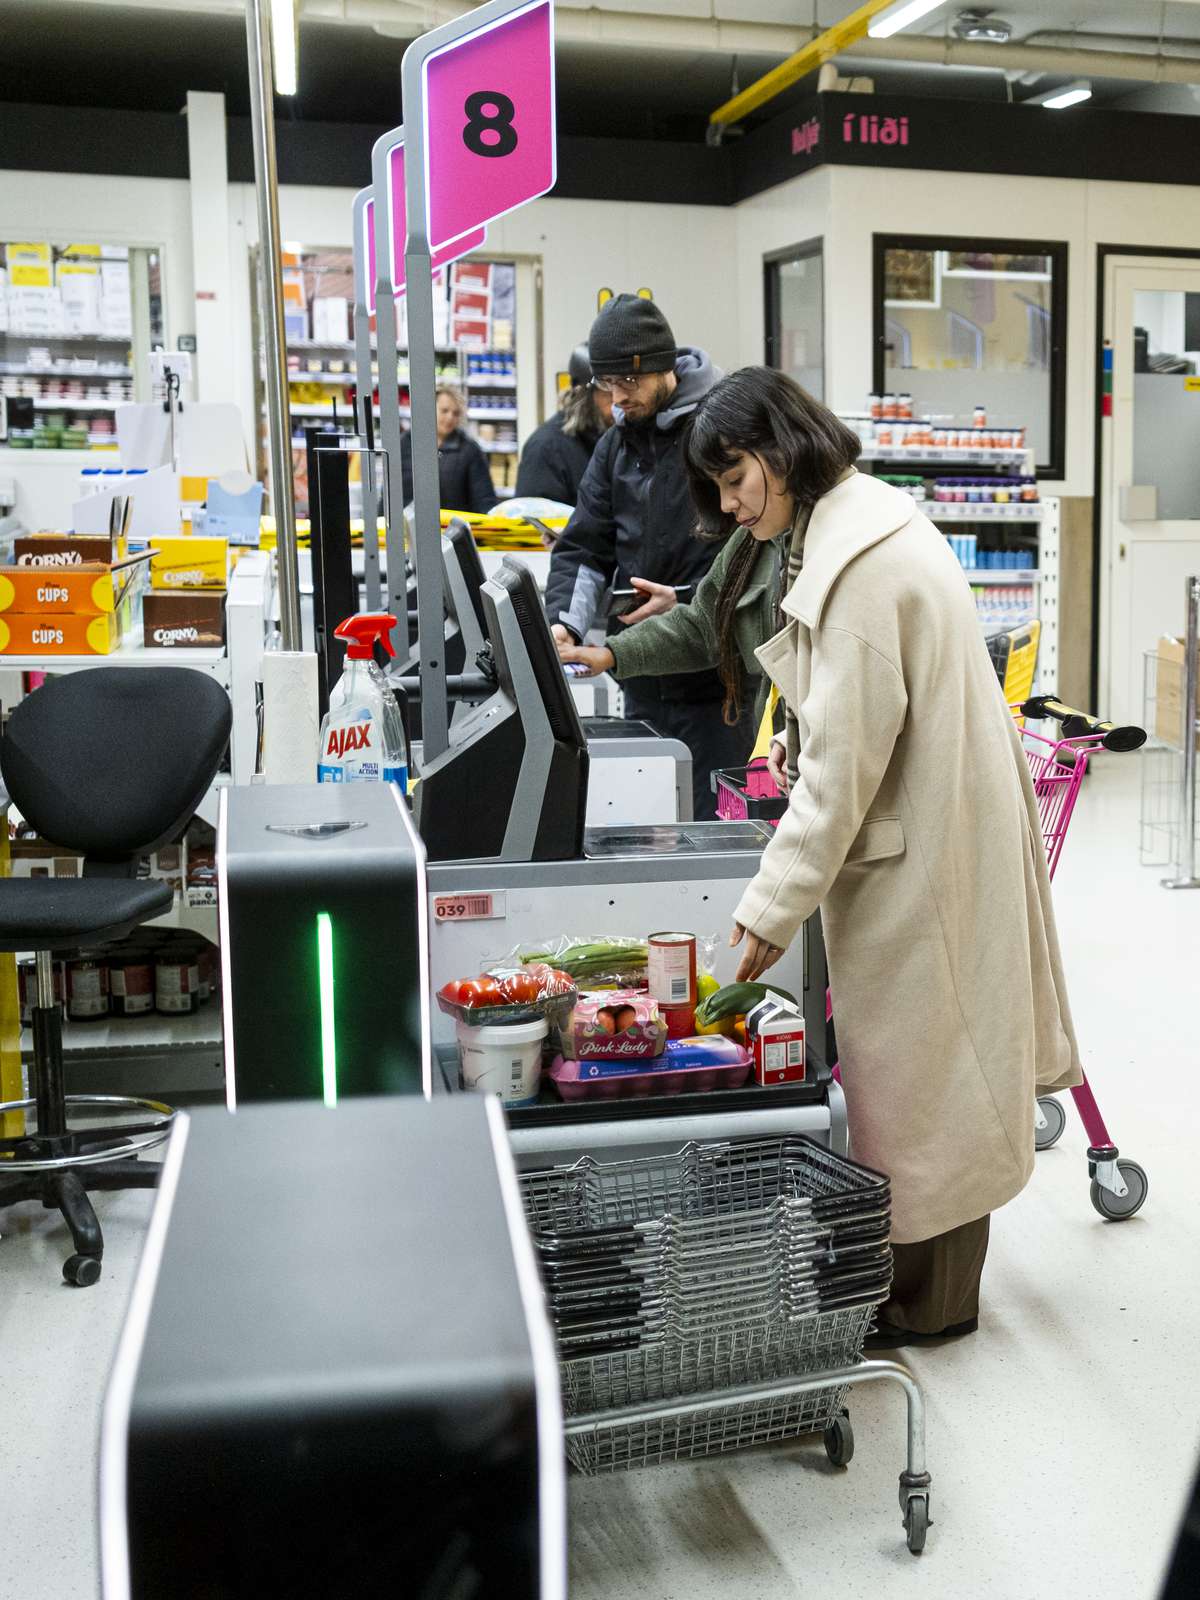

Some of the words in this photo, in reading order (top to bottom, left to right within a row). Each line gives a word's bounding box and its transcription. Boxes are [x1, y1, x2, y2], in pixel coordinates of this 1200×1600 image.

[463, 91, 518, 157] 8
[37, 588, 69, 602] CUPS
[31, 629, 64, 644] CUPS
[153, 627, 198, 642] CORNY
[326, 723, 371, 759] AJAX
[436, 904, 466, 917] 039
[578, 1040, 615, 1055] Pink
[615, 1040, 650, 1054] Lady
